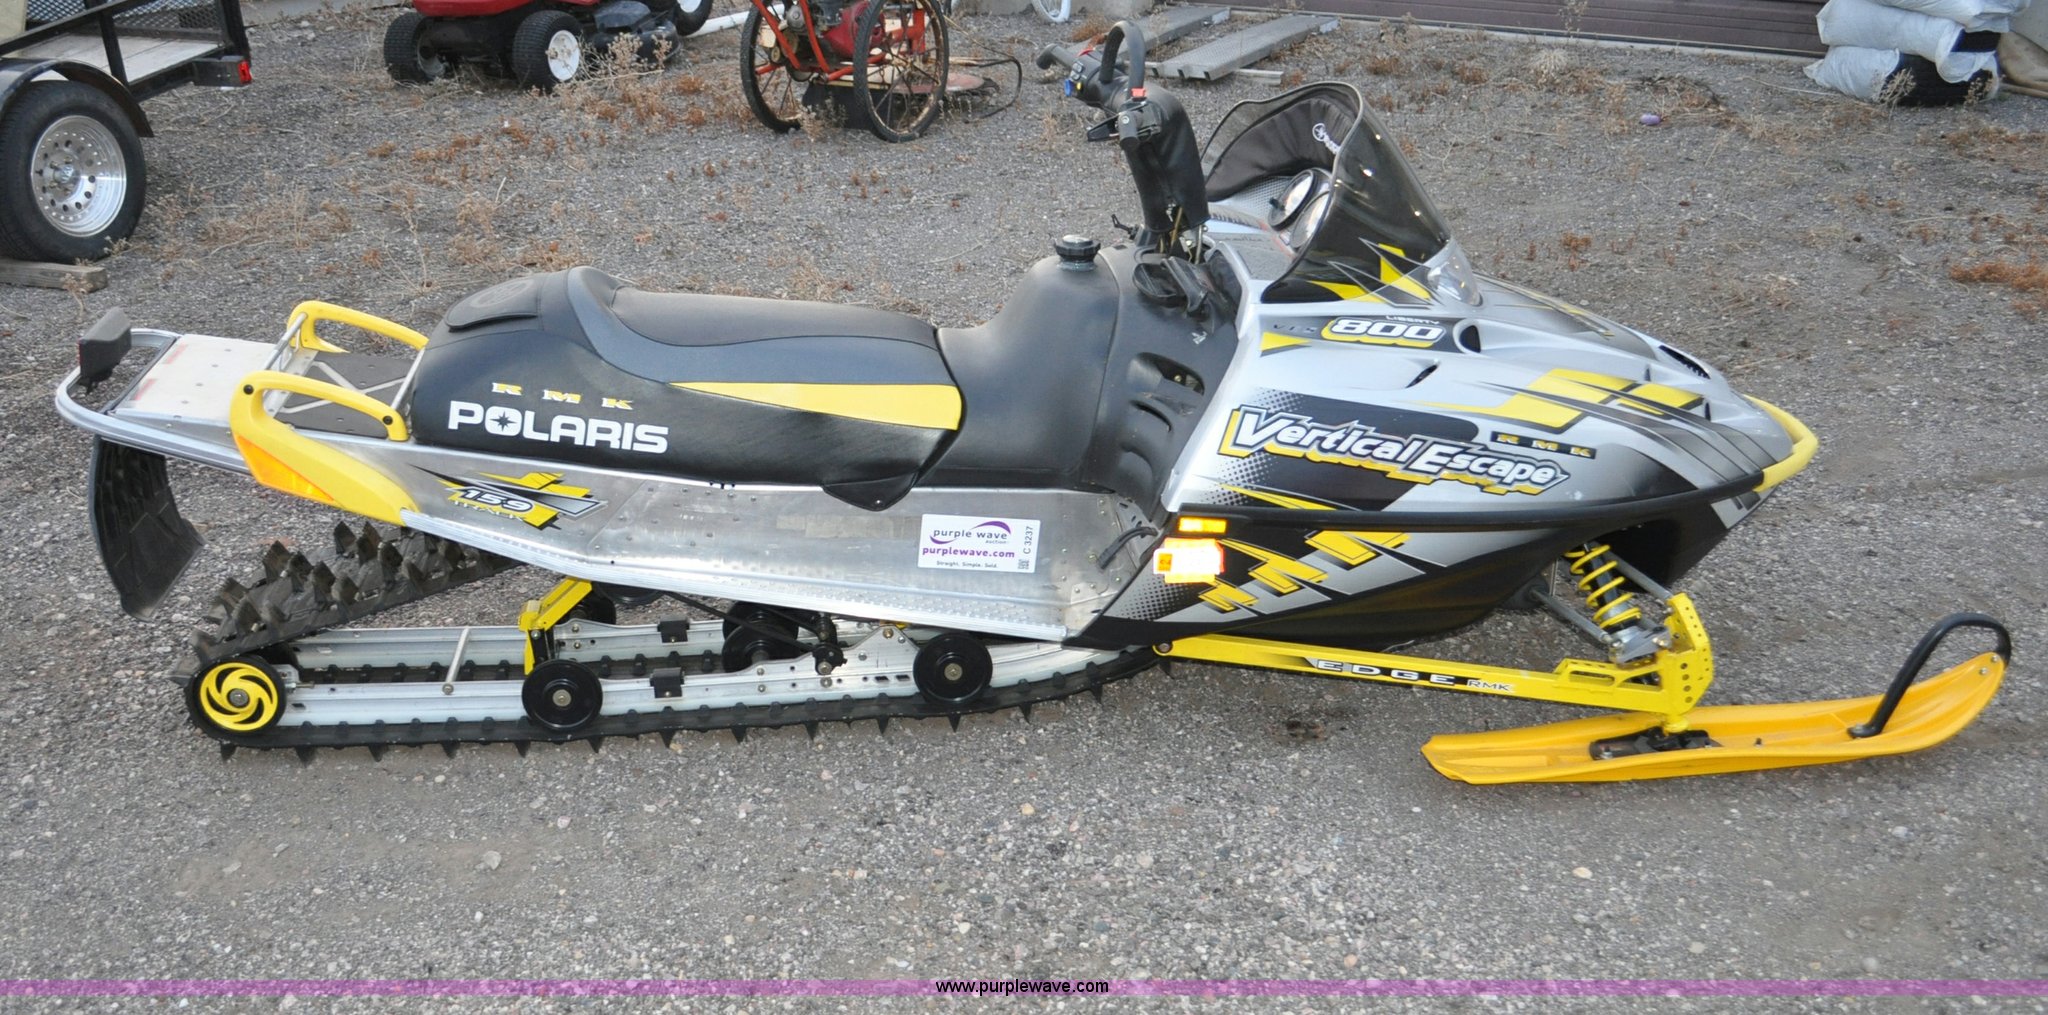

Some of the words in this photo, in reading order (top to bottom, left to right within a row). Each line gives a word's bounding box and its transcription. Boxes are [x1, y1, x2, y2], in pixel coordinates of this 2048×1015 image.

[1330, 318, 1444, 341] 800
[1385, 315, 1440, 325] LIBERTY
[448, 400, 669, 454] POLARIS
[1233, 407, 1418, 465] Vertical
[1411, 442, 1560, 488] Escape
[462, 489, 534, 512] 159
[933, 529, 972, 539] purple
[976, 531, 1008, 540] wave
[1024, 526, 1034, 547] 3237
[922, 546, 1015, 558] purplewave.com
[1023, 547, 1031, 555] C
[1317, 659, 1456, 686] EDGE
[1467, 679, 1511, 692] RMK
